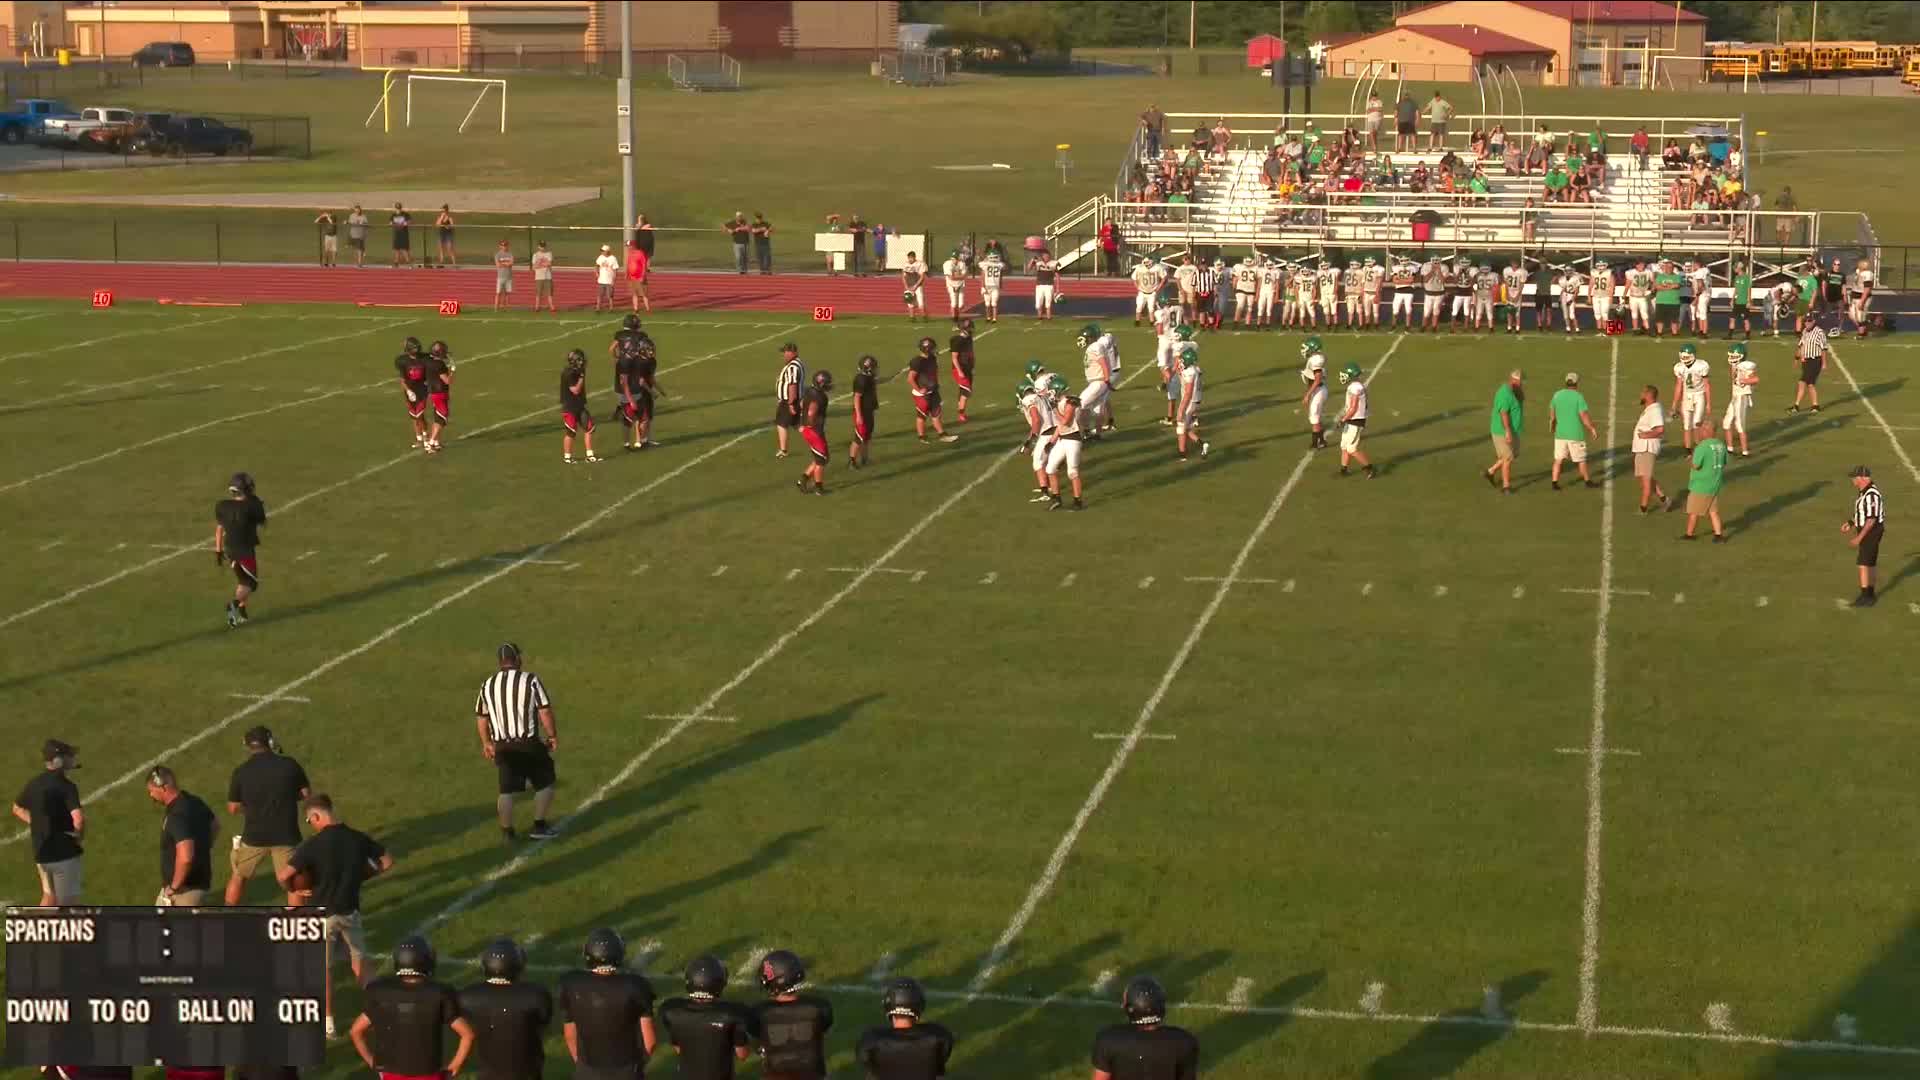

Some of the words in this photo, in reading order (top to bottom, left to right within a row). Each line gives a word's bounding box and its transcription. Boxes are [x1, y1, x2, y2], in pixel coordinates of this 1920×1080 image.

[94, 292, 109, 306] 10
[441, 301, 457, 313] 20
[815, 307, 831, 319] 30
